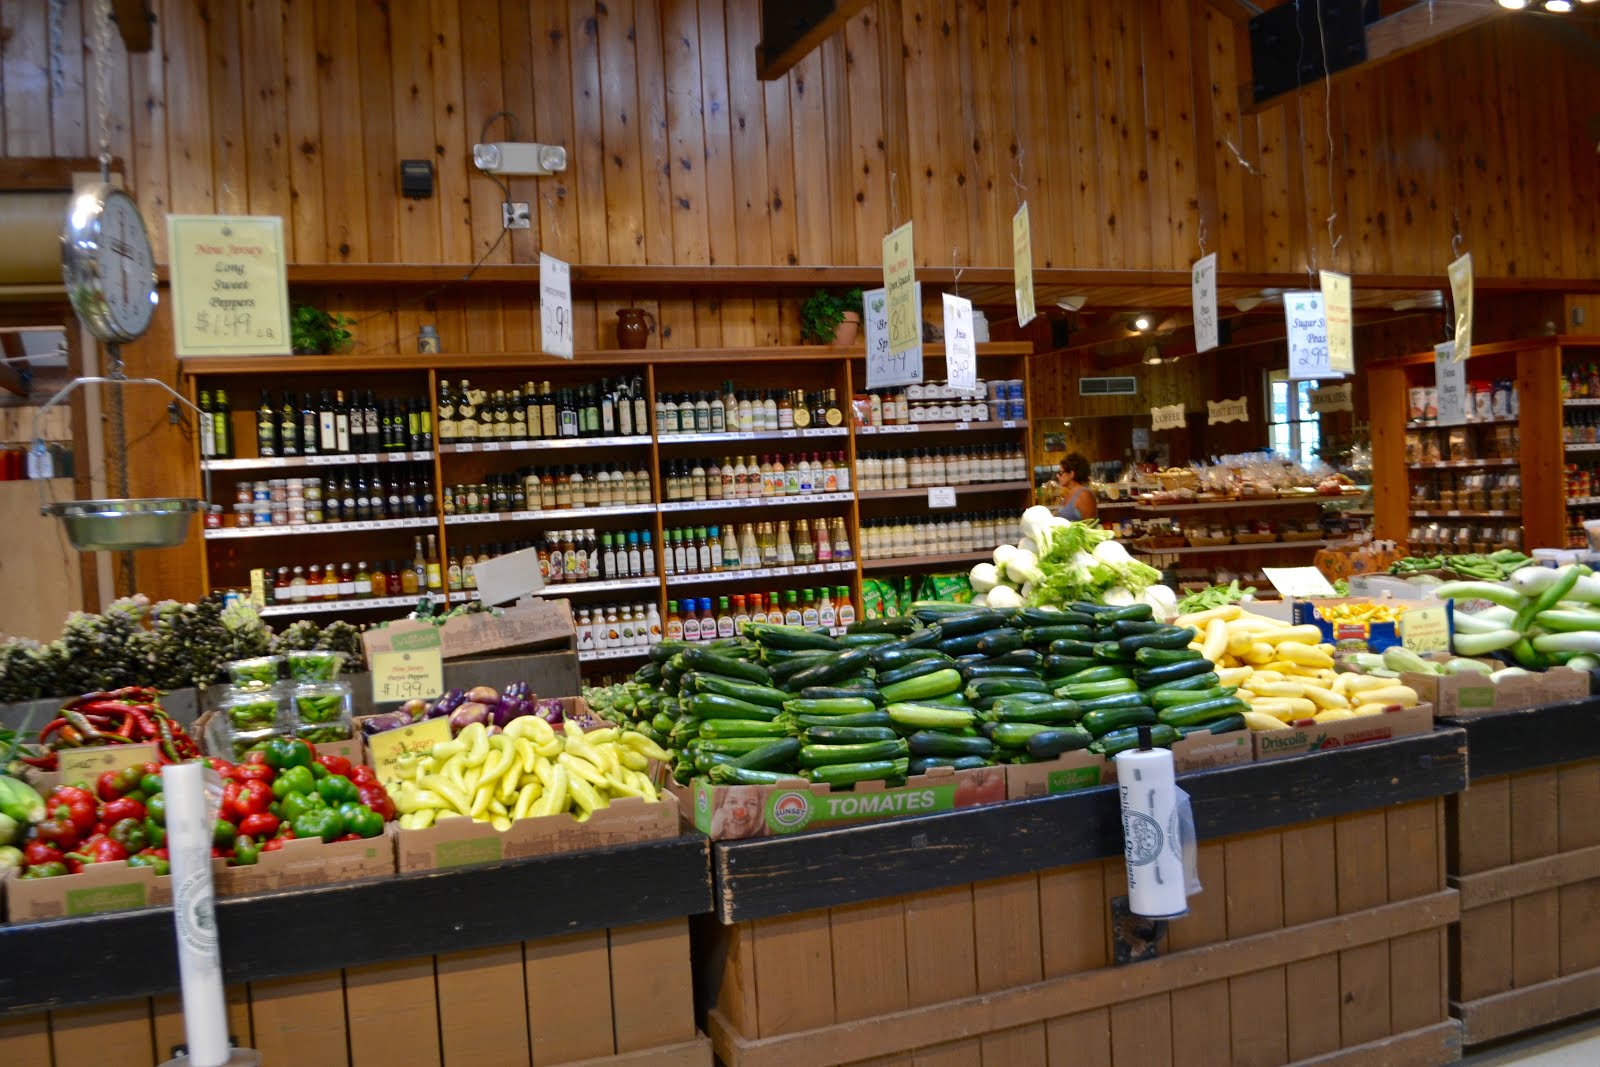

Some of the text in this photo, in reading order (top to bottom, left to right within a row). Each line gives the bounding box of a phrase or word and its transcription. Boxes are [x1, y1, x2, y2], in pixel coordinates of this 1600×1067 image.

[215, 262, 244, 276] Long
[212, 280, 249, 291] Sweet
[209, 297, 255, 310] Peppers
[1292, 318, 1317, 330] Sugar
[1155, 411, 1181, 424] COFFEE
[827, 790, 935, 817] TOMATES
[776, 808, 806, 818] SUNSET
[1126, 840, 1137, 889] Orchards
